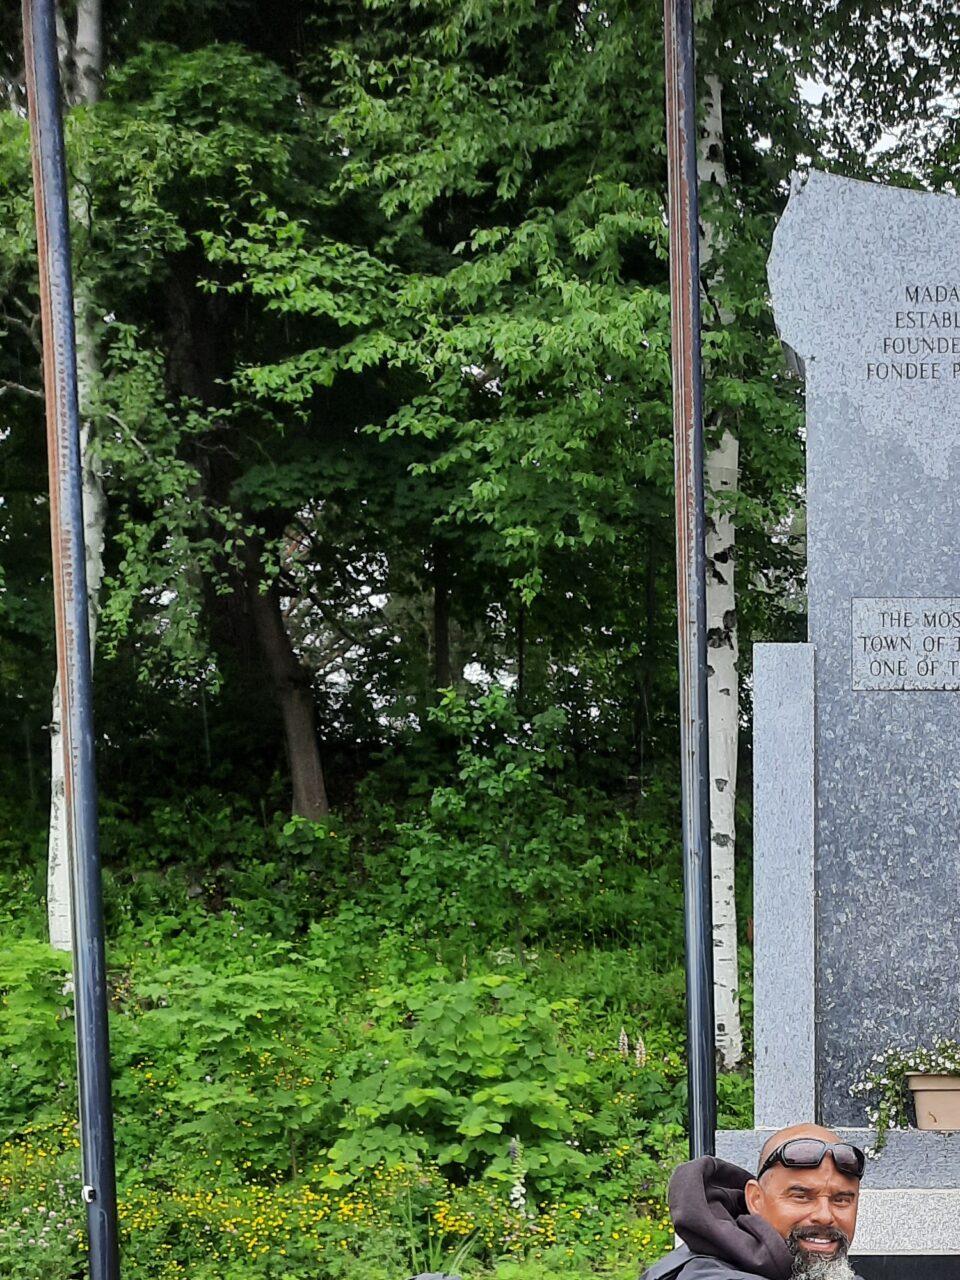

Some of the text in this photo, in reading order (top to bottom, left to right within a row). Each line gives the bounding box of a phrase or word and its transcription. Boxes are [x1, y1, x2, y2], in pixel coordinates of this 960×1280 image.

[879, 611, 913, 628] THE
[859, 636, 912, 652] TOWN
[922, 636, 946, 652] OF
[869, 660, 907, 677] ONE
[916, 659, 940, 677] OF
